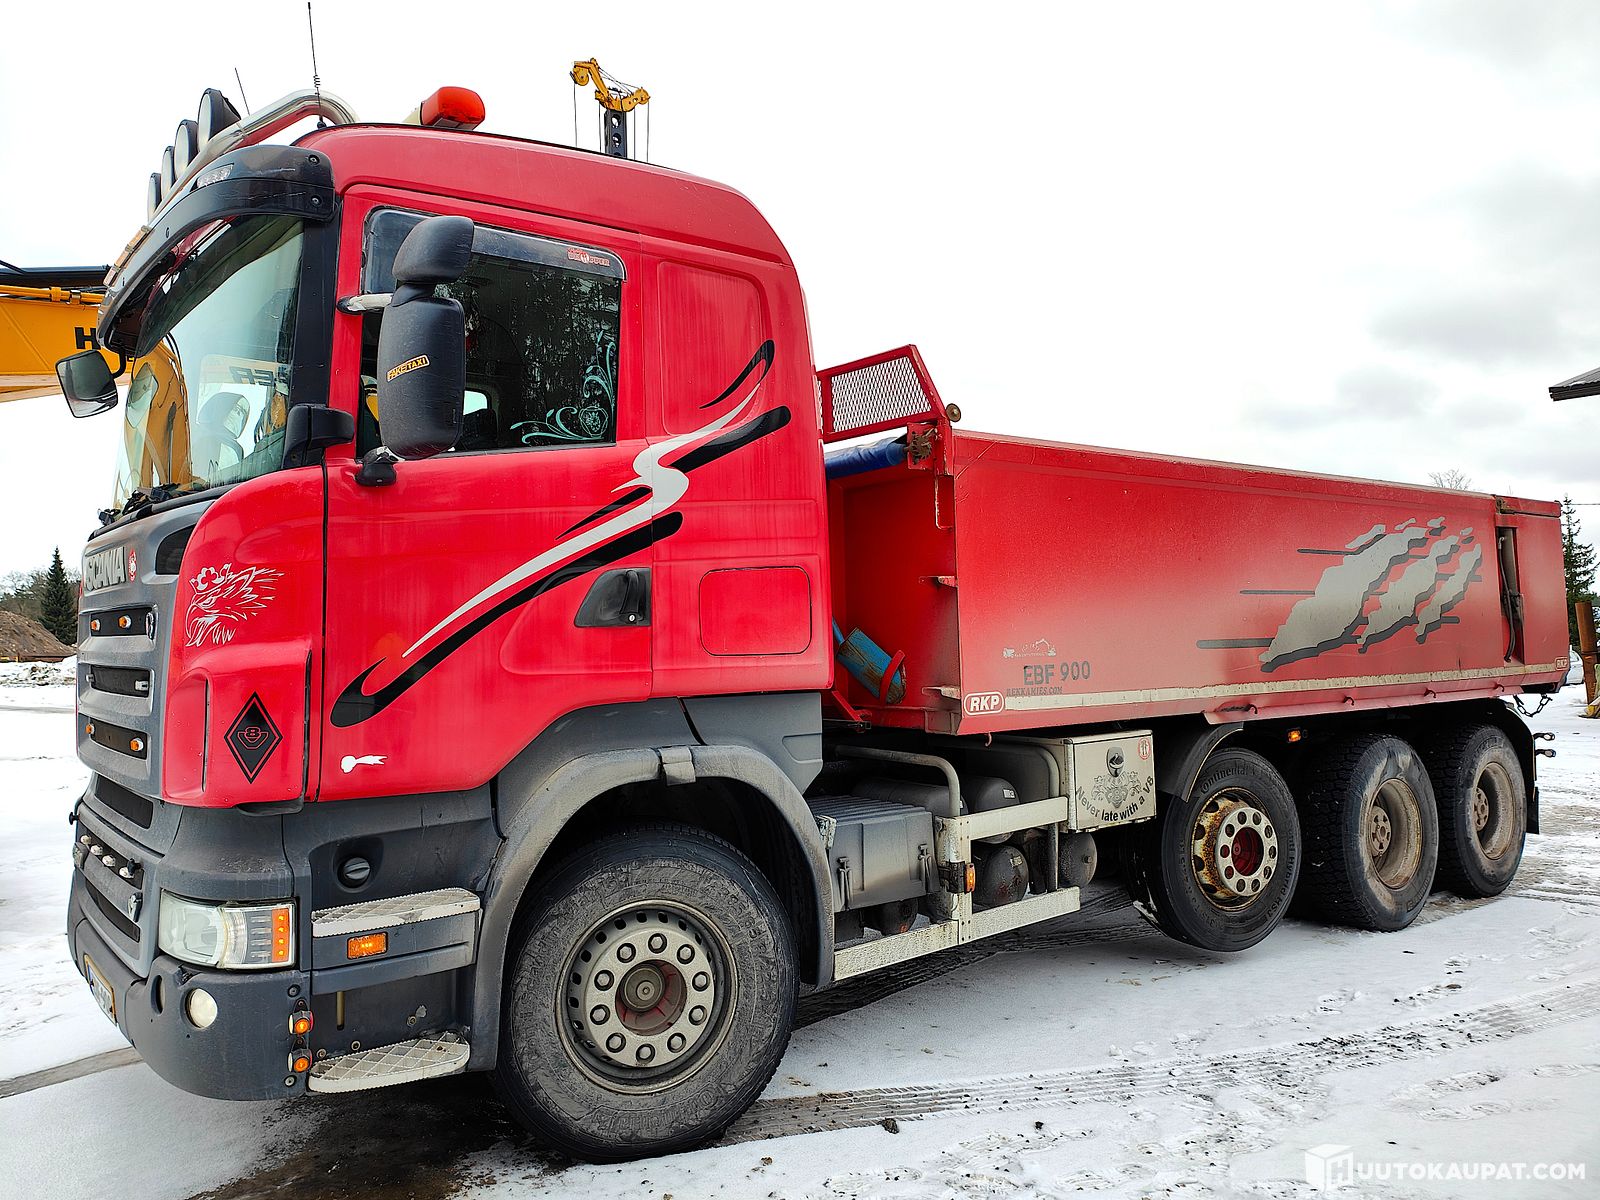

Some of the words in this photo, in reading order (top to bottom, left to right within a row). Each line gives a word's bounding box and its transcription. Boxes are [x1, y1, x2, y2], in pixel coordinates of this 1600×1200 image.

[84, 546, 126, 591] SCANIA
[1023, 664, 1055, 685] EBF
[1060, 660, 1090, 681] 900
[970, 695, 1000, 712] RKP
[1076, 785, 1101, 818] Never
[1101, 808, 1119, 822] late
[1119, 802, 1139, 820] with
[1138, 795, 1145, 806] a
[1142, 775, 1155, 794] V8
